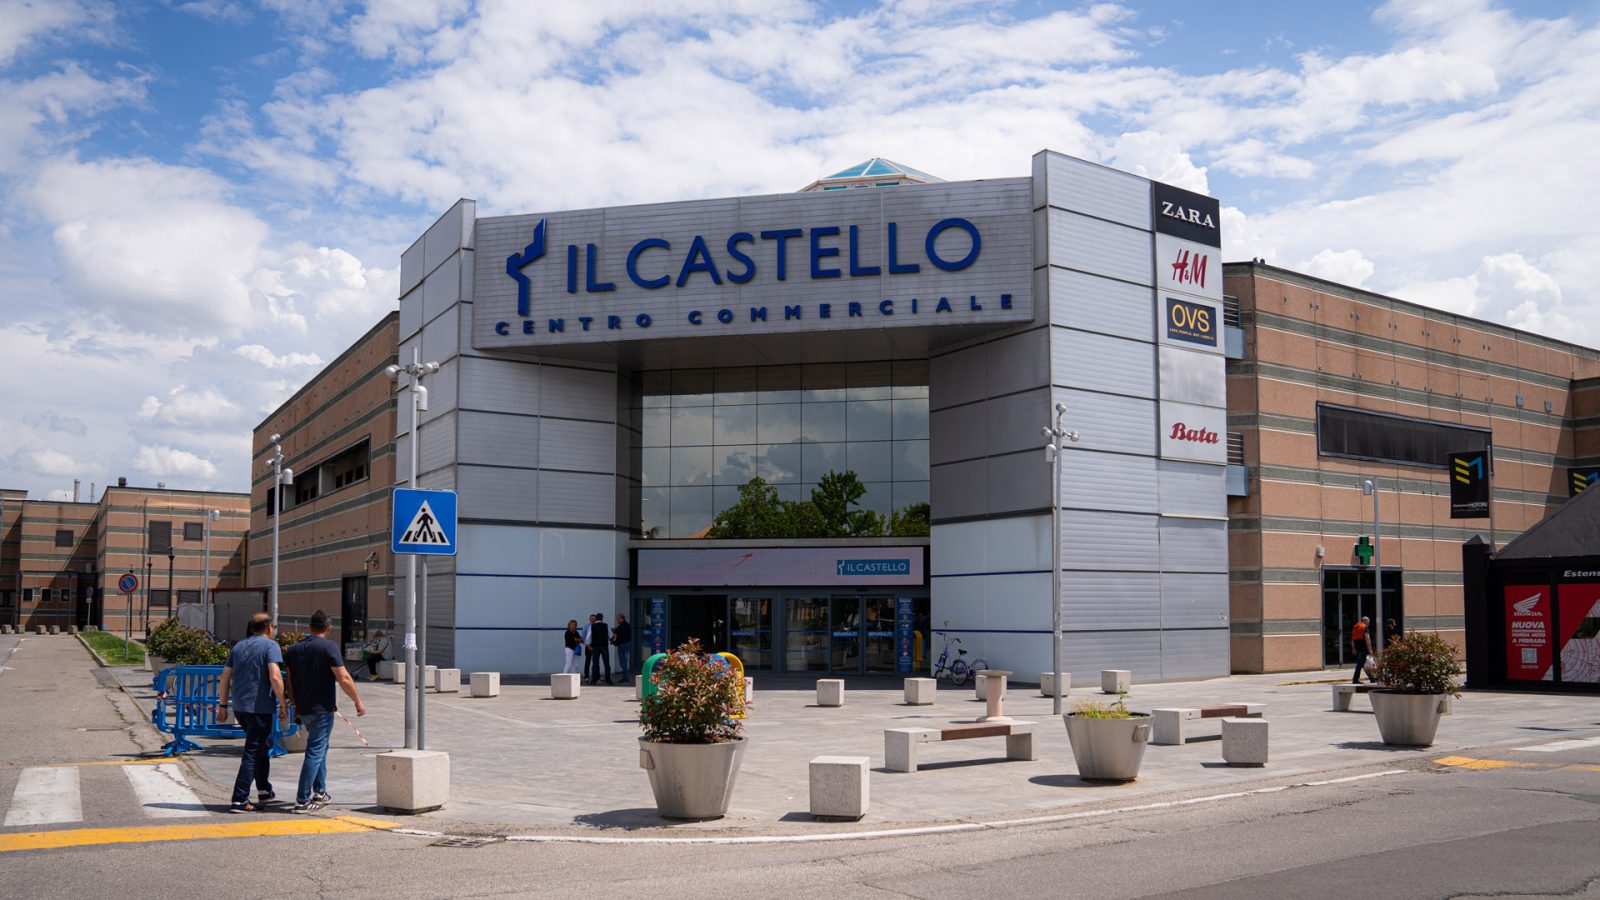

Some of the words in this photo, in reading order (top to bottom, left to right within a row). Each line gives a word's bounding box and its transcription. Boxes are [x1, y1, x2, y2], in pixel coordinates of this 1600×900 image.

[1161, 201, 1216, 229] ZARA
[567, 243, 616, 294] IL
[626, 217, 982, 290] CASTELLO
[1171, 248, 1208, 289] H&M
[495, 313, 652, 336] CENTRO
[687, 293, 1013, 325] COMMERCIALE
[1171, 304, 1210, 333] OVS
[1169, 422, 1219, 444] Bata
[847, 563, 856, 572] IL
[856, 562, 907, 572] CASTELLO
[1512, 621, 1545, 629] NUOVA
